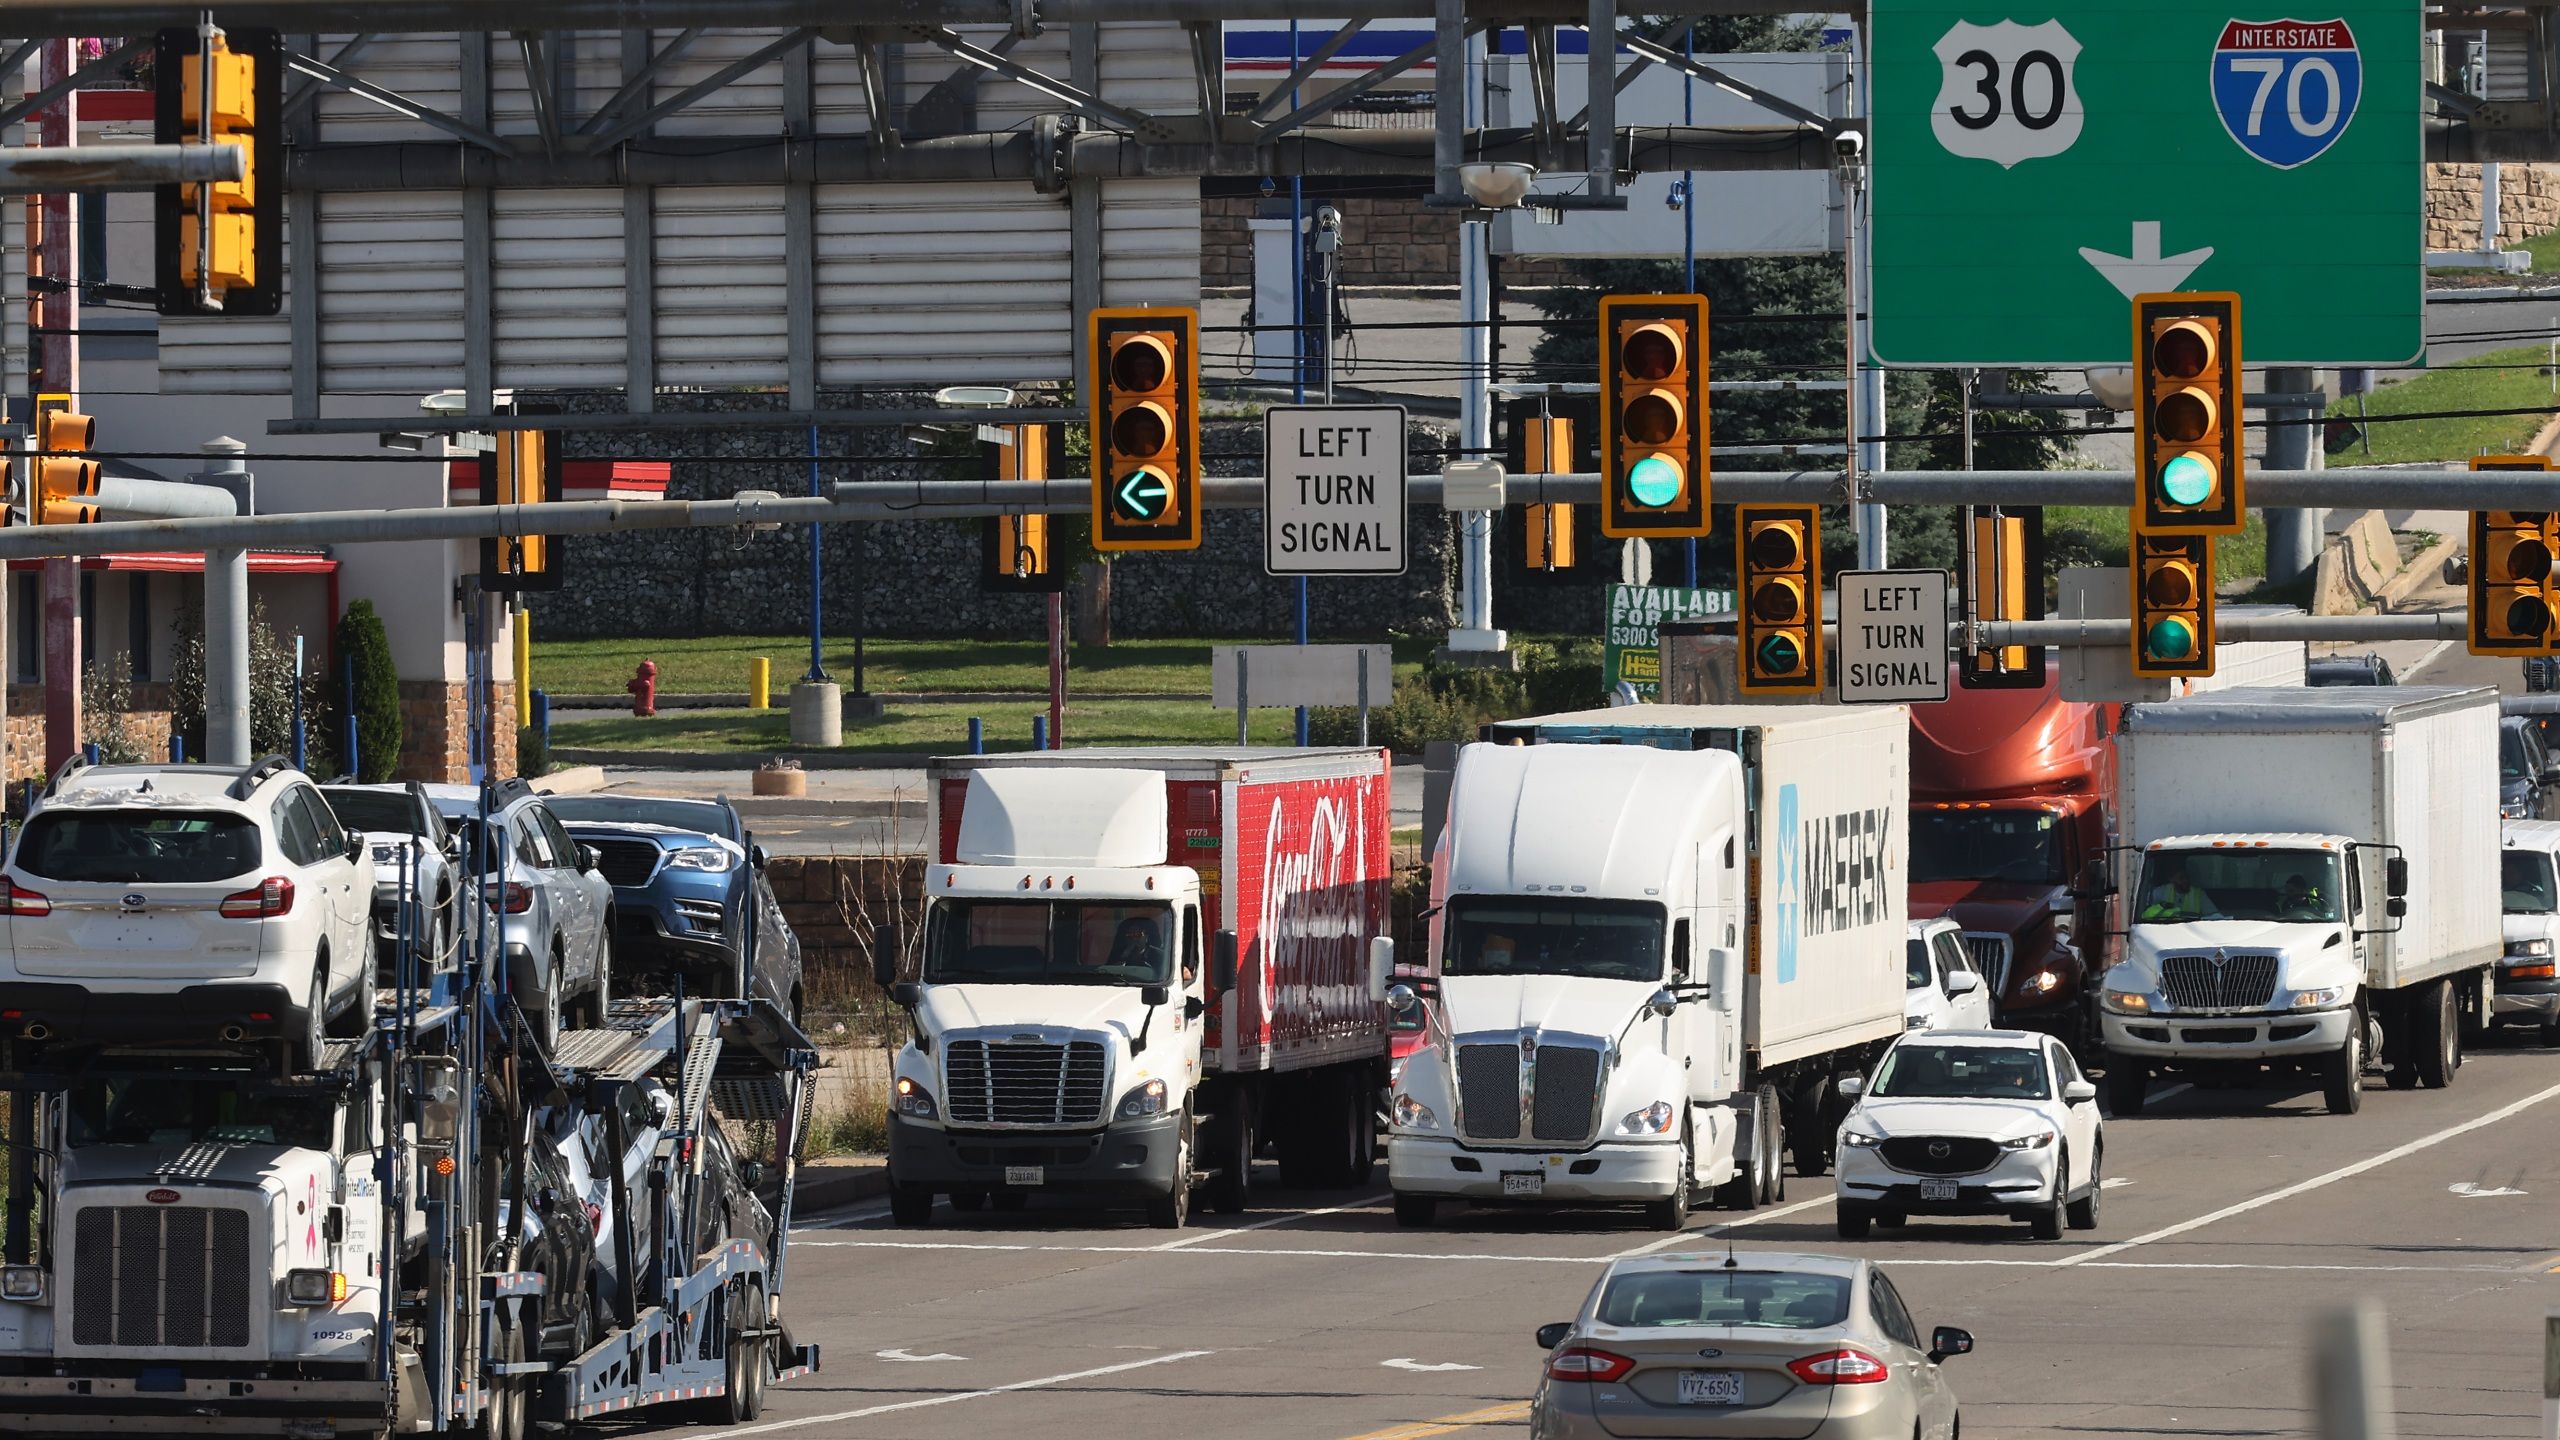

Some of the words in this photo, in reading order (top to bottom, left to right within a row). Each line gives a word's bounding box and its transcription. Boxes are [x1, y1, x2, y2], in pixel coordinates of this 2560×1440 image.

[2235, 28, 2337, 47] INTERSTATE
[1949, 50, 2066, 130] 30
[2230, 57, 2341, 137] 70
[1299, 427, 1371, 457] LEFT
[1296, 475, 1374, 505] TURN
[1281, 522, 1391, 553] SIGNAL
[1864, 587, 1921, 611] LEFT
[1612, 608, 1662, 626] FOR
[1612, 626, 1648, 646] 5300
[1651, 629, 1659, 646] S
[1862, 625, 1924, 649] TURN
[1849, 662, 1937, 687] SIGNAL
[1804, 806, 1889, 937] MAERSK
[312, 1331, 353, 1340] 10928
